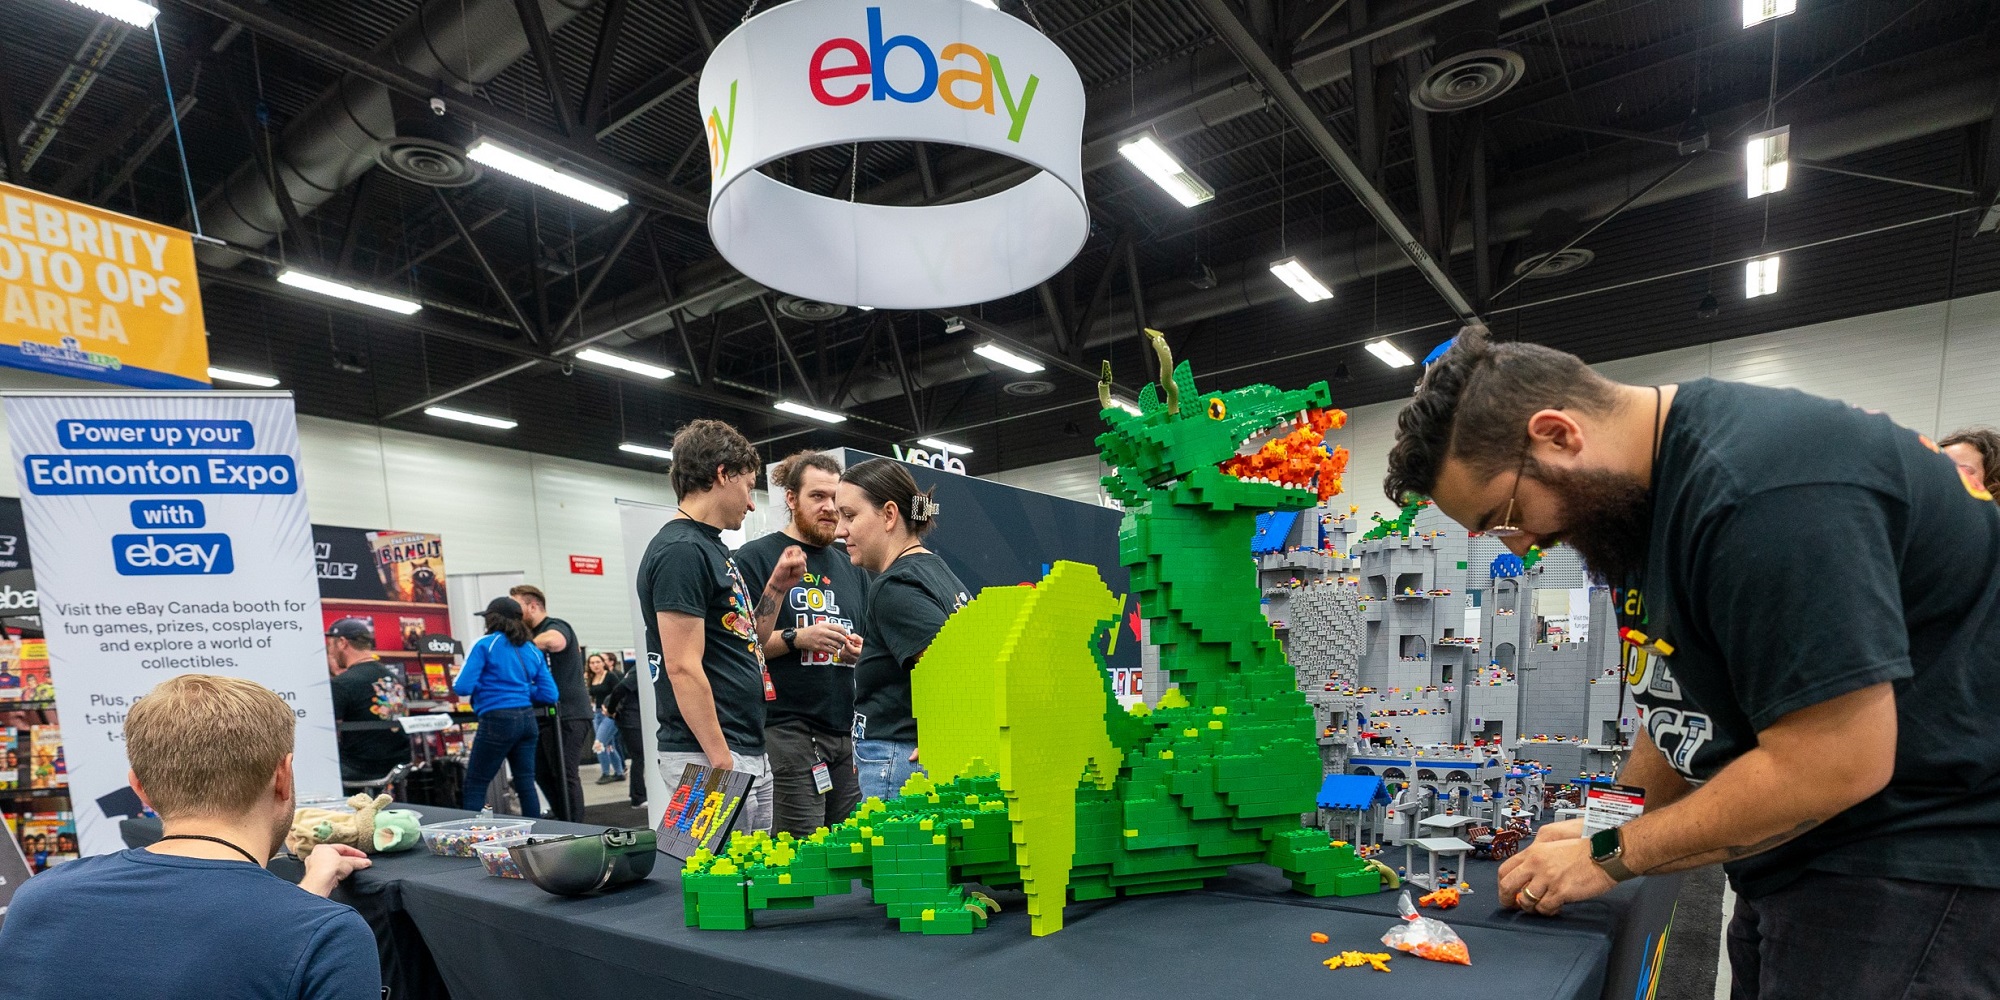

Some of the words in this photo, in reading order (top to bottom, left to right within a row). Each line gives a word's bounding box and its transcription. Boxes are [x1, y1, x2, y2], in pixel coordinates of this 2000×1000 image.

[809, 7, 1040, 143] ebay
[0, 194, 168, 272] EBRITY
[95, 262, 186, 316] OPS
[3, 283, 130, 345] AREA
[68, 422, 145, 442] Power
[151, 423, 182, 447] up
[186, 426, 242, 446] your
[30, 457, 200, 485] Edmonton
[208, 458, 290, 490] Expo
[143, 504, 194, 524] with
[125, 536, 220, 572] ebay
[381, 539, 441, 565] BANDIT
[56, 603, 92, 616] Visit
[95, 603, 122, 615] the
[126, 602, 165, 617] eBay
[168, 601, 229, 614] Canada
[233, 600, 280, 613] booth
[284, 599, 306, 612] for
[789, 586, 840, 615] COL
[64, 622, 89, 634] fun
[93, 623, 153, 637] games,
[157, 620, 209, 635] prizes,
[212, 619, 302, 634] cosplayers,
[100, 639, 130, 652] and
[134, 638, 193, 653] explore
[197, 640, 207, 650] a
[210, 636, 253, 650] world
[256, 636, 271, 648] of
[141, 655, 238, 669] collectibles.
[90, 694, 129, 706] Plus,
[665, 772, 740, 847] ebay
